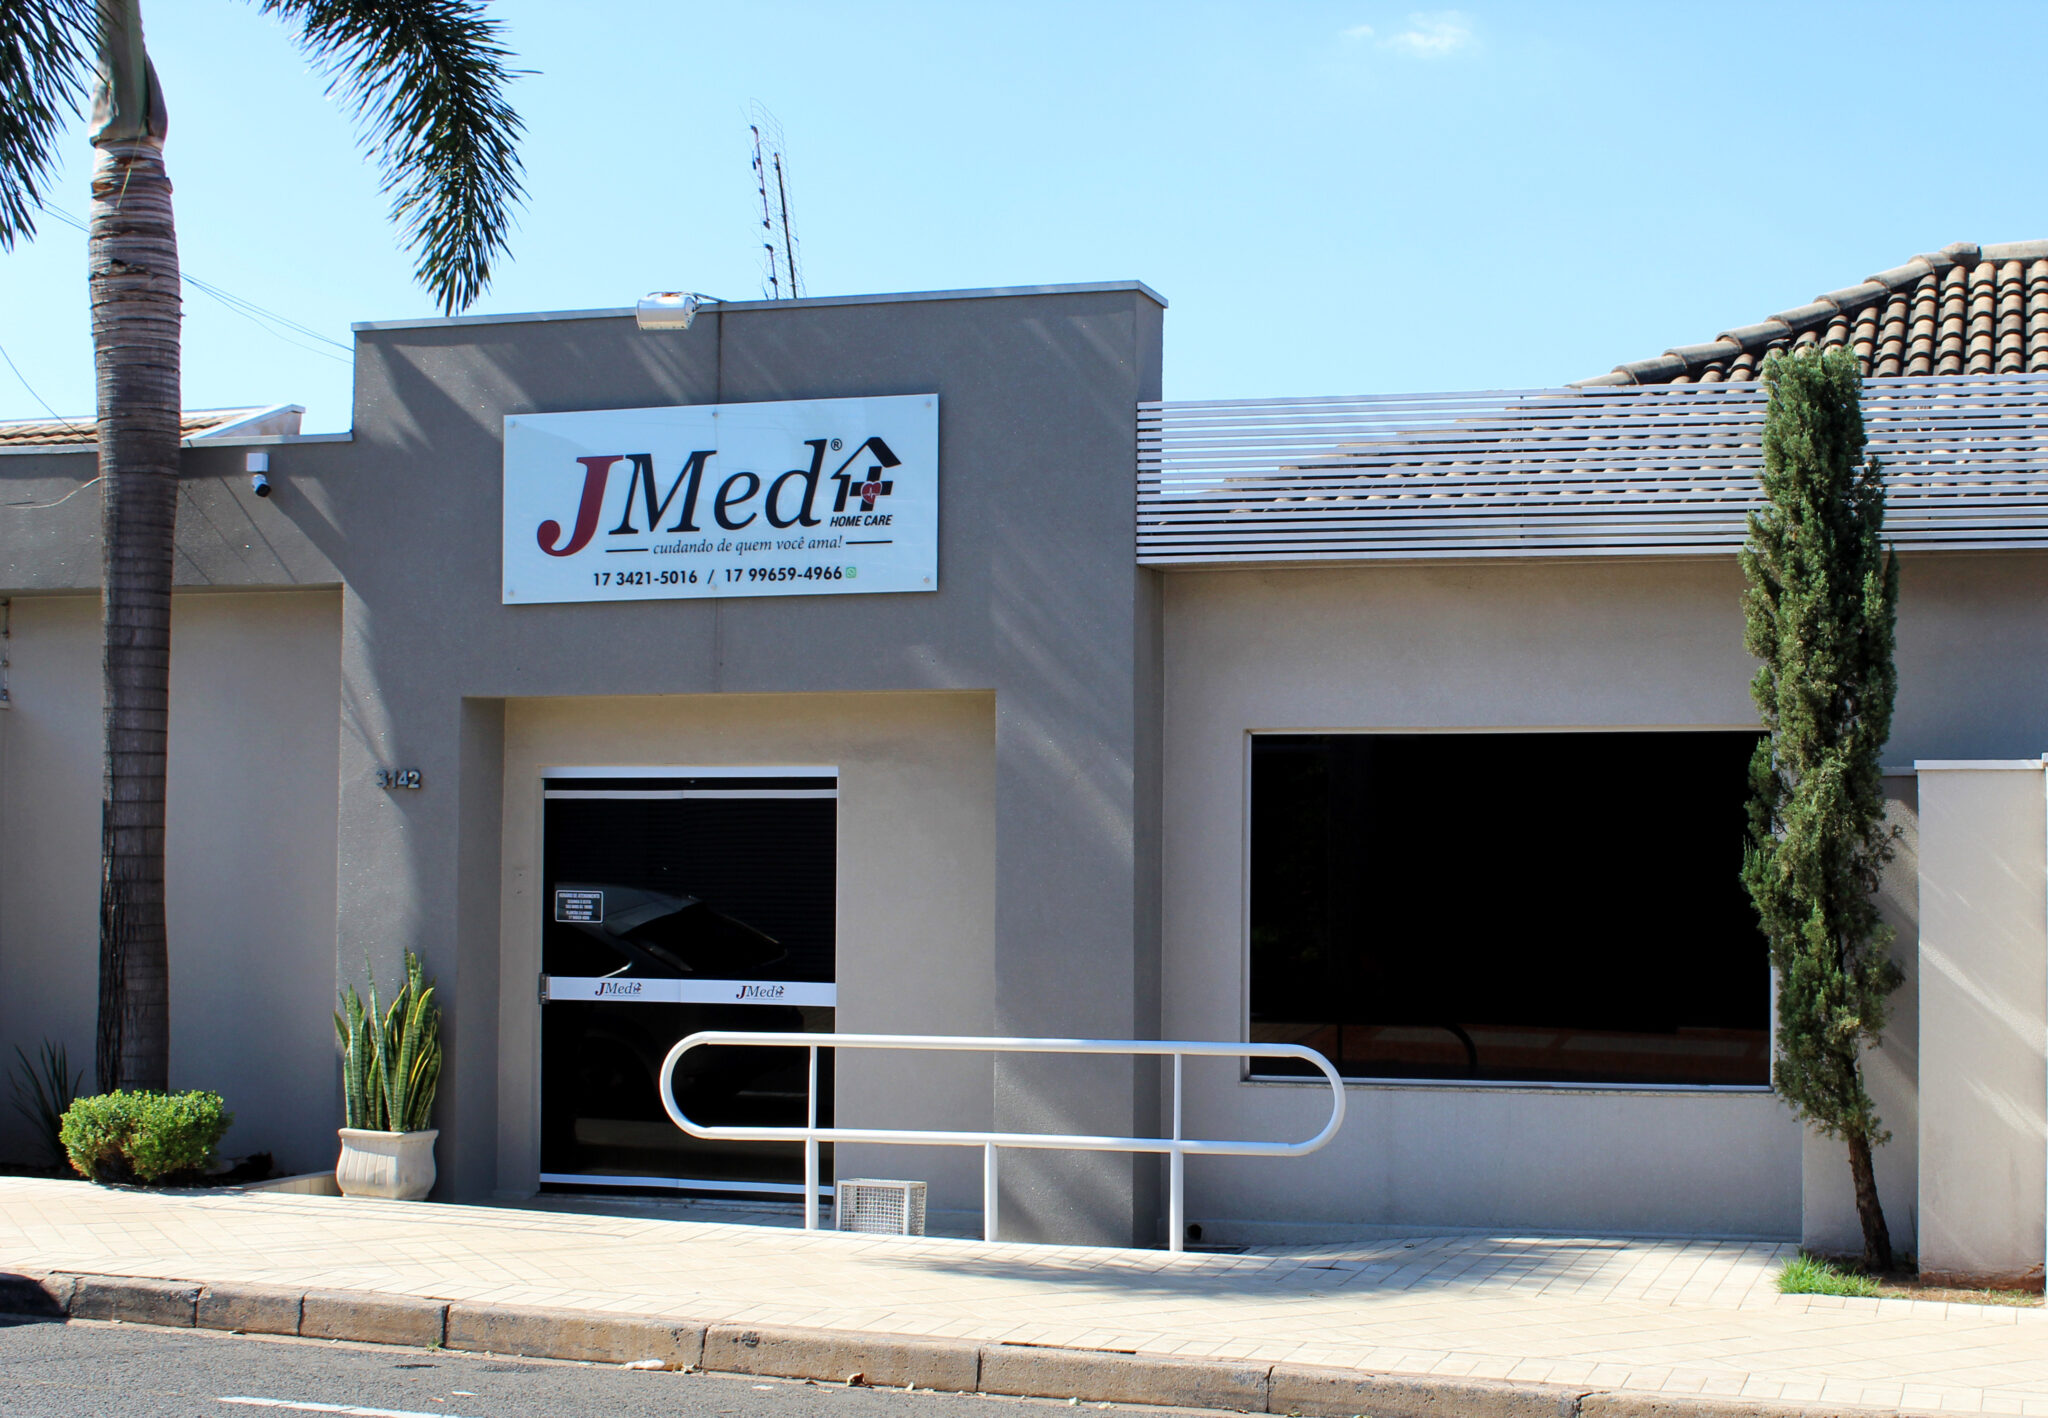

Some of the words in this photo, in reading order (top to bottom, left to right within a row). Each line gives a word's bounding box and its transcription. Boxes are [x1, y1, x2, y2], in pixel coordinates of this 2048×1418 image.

[536, 438, 828, 558] JMed
[830, 516, 862, 528] HOME
[864, 514, 893, 526] CARE
[653, 540, 714, 555] cuidando
[717, 538, 733, 552] de
[735, 540, 772, 556] quem
[776, 536, 805, 550] você
[808, 535, 843, 549] ama!
[593, 573, 611, 587] 17
[616, 569, 698, 586] 3421-5016
[725, 569, 743, 582] 17
[749, 566, 843, 582] 99659-4966
[375, 769, 421, 789] 3142
[594, 982, 634, 996] JMed
[736, 985, 777, 999] JMed
